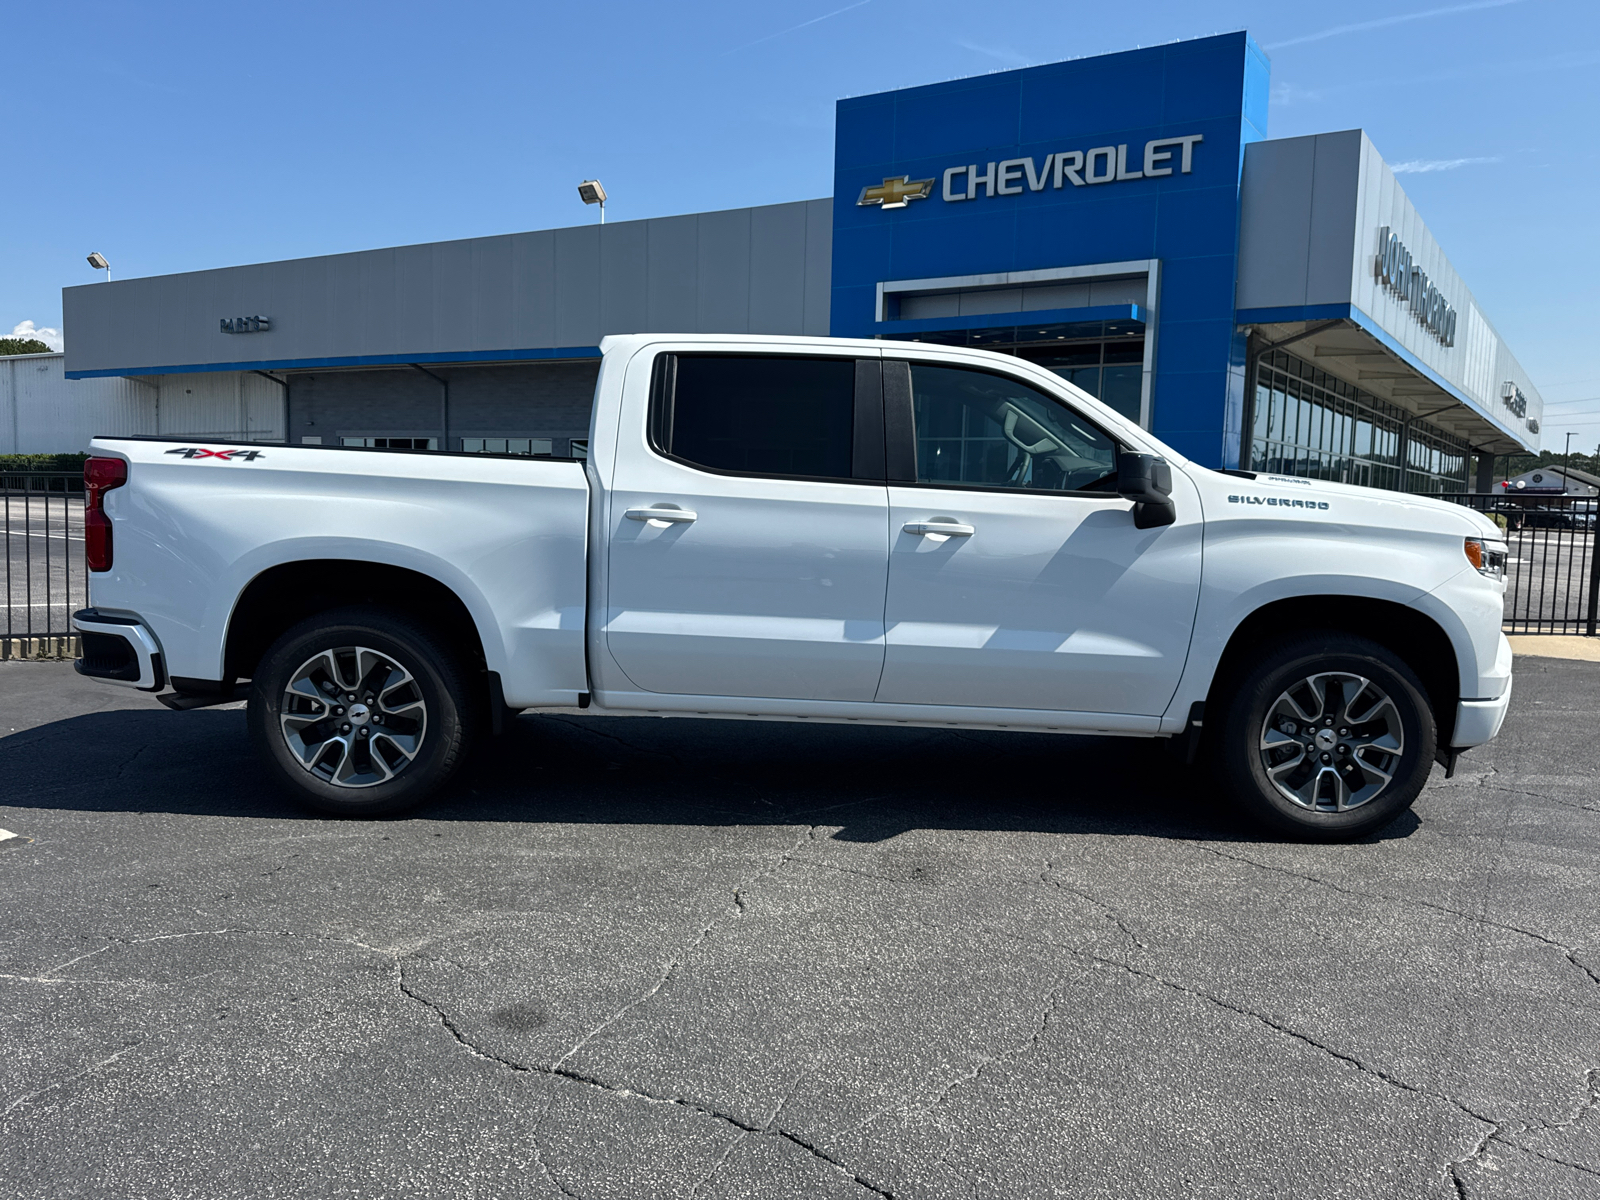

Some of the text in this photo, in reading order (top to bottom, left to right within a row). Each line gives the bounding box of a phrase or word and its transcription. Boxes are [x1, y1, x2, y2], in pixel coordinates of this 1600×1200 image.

[942, 134, 1203, 202] CHEVROLET
[1377, 225, 1412, 301] JOHN
[220, 315, 265, 333] PARTS
[1227, 494, 1330, 510] SILVERADO
